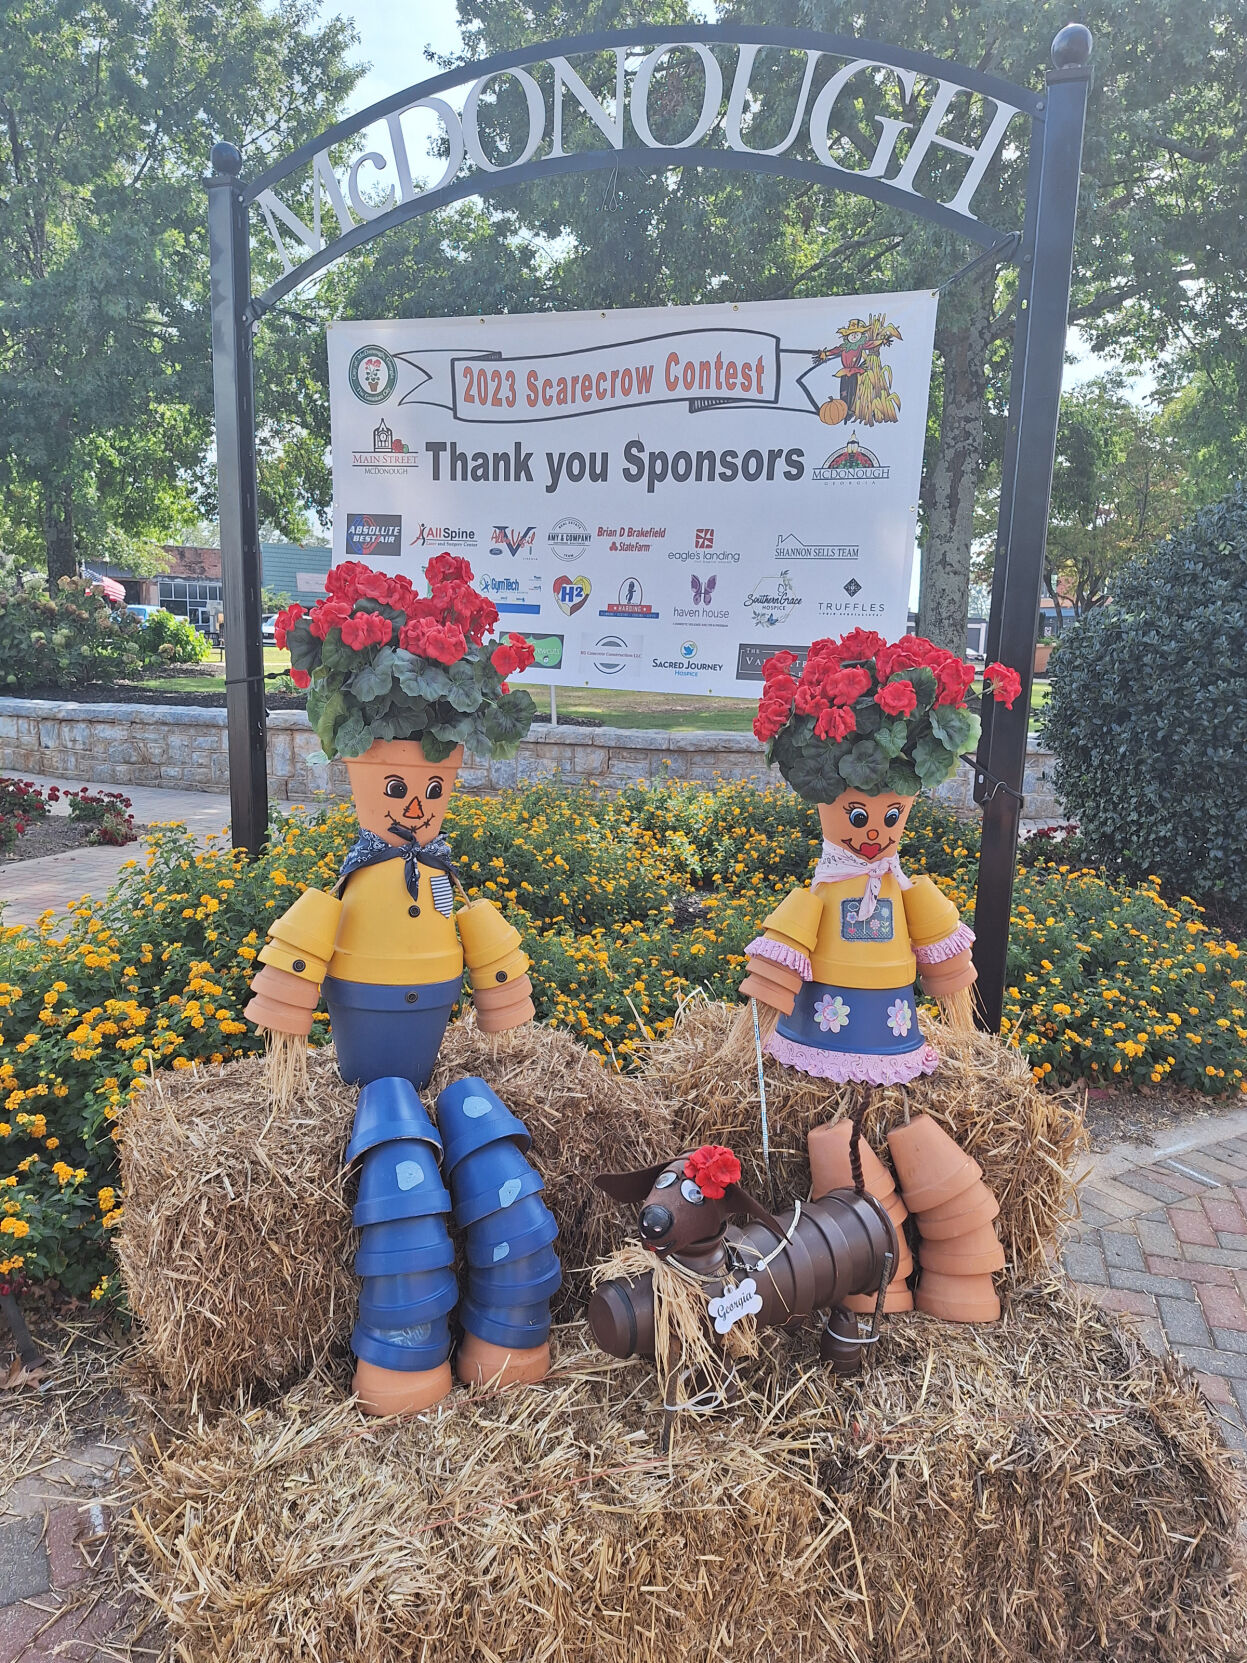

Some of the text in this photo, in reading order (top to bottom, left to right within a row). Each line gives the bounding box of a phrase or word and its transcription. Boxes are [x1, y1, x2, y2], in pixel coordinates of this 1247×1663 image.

[462, 350, 765, 408] 2023 Scarecrow Contest
[425, 441, 534, 482] Thank
[546, 451, 609, 493] you
[622, 439, 805, 493] Sponsors
[348, 525, 400, 535] ABSOLUTE
[597, 526, 667, 538] Brian D Brakefield
[566, 534, 592, 542] COMPANY
[668, 550, 741, 563] eagle's landing
[775, 548, 859, 558] SHANNON SELLS TEAM
[673, 606, 700, 618] haven
[702, 607, 730, 619] house
[818, 602, 885, 612] TRUFFLES
[652, 658, 723, 672] SACRED JOURNEY
[717, 1291, 753, 1321] Georgia
